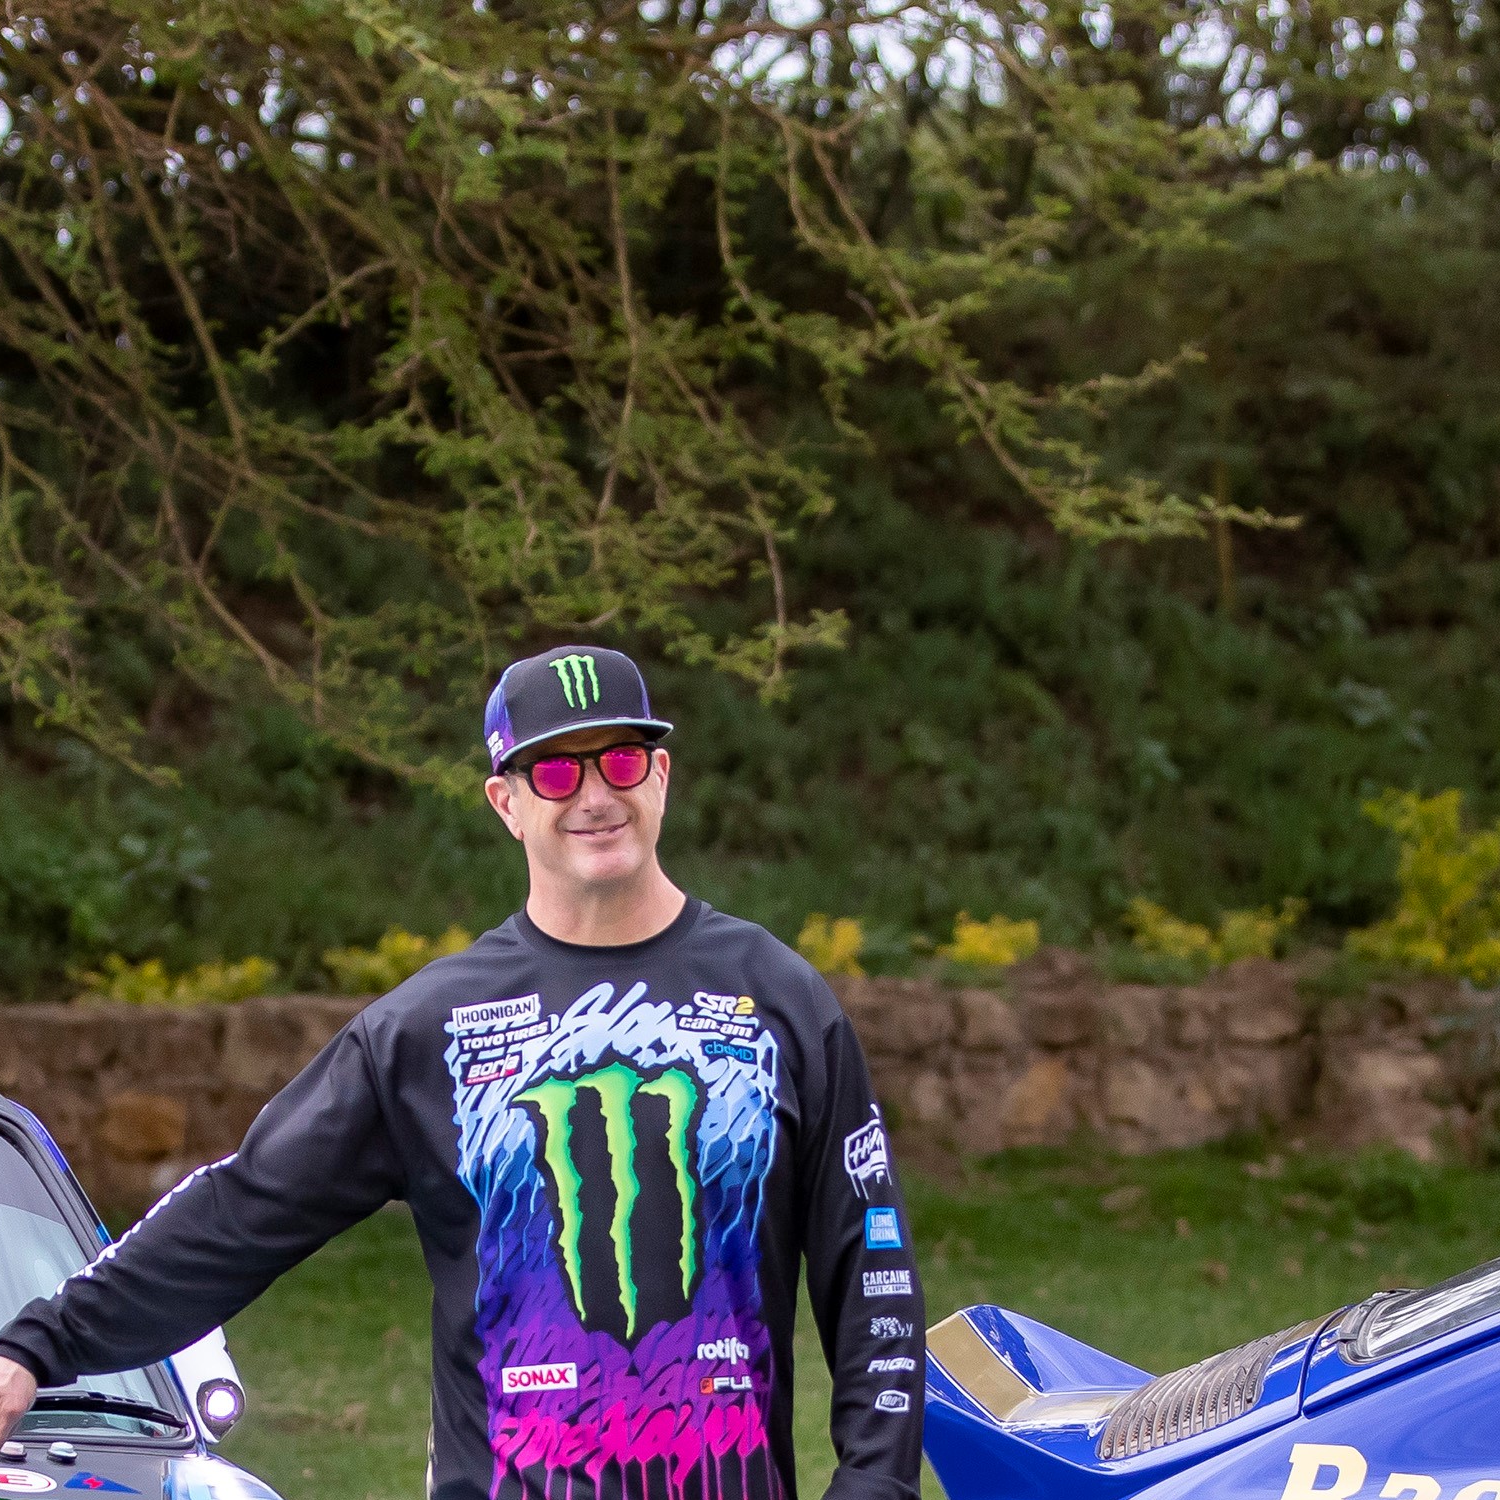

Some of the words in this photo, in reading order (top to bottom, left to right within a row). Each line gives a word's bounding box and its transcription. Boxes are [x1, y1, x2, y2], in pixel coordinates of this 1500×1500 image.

[693, 991, 755, 1015] CSR2
[462, 1034, 505, 1050] TOYO
[506, 1022, 548, 1042] TIRES
[679, 1017, 753, 1038] can-am
[507, 1368, 571, 1388] SONAX
